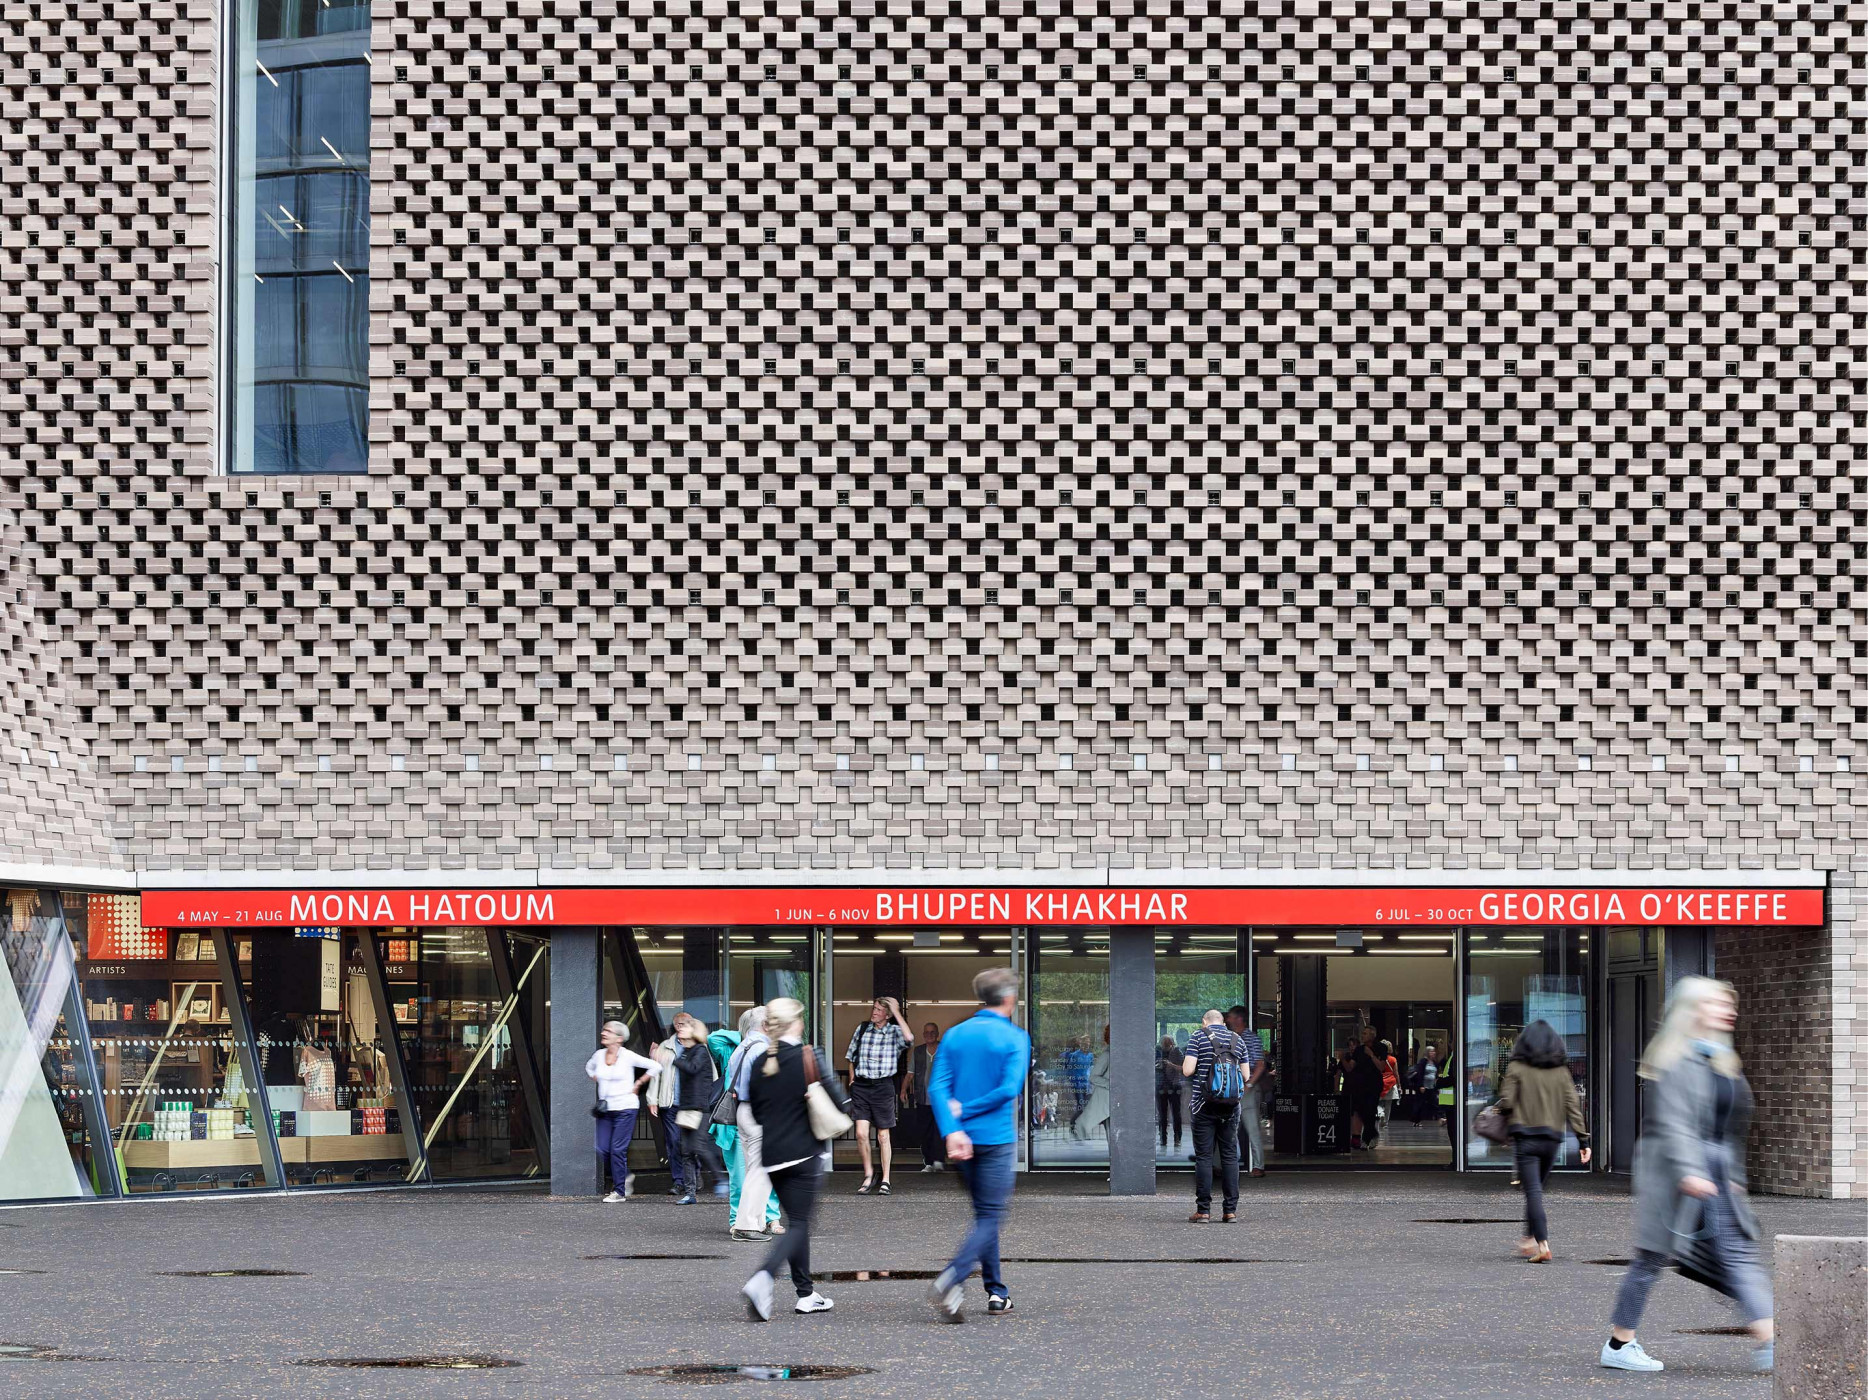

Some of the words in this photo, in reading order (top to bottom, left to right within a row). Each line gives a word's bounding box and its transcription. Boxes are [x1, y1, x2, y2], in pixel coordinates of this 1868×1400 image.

[177, 911, 185, 922] 4
[190, 911, 219, 922] MAY
[235, 910, 249, 922] 21
[255, 910, 283, 921] AUG
[289, 894, 395, 921] MONA
[409, 893, 554, 921] HATOUM
[775, 908, 780, 920] 1
[785, 909, 812, 921] JUN
[828, 909, 837, 920] 6
[841, 908, 870, 920] NOV
[876, 893, 1010, 921] BHUPEN
[1026, 893, 1188, 921] KHAKHAR
[1375, 908, 1383, 920] 6
[1386, 908, 1411, 920] JUL
[1427, 908, 1444, 920] 30
[1447, 908, 1473, 920] OCT
[1479, 893, 1626, 921] GEORGIA
[89, 966, 126, 974] ARTISTS
[347, 966, 403, 974] MANES
[1317, 1124, 1336, 1143] £4
